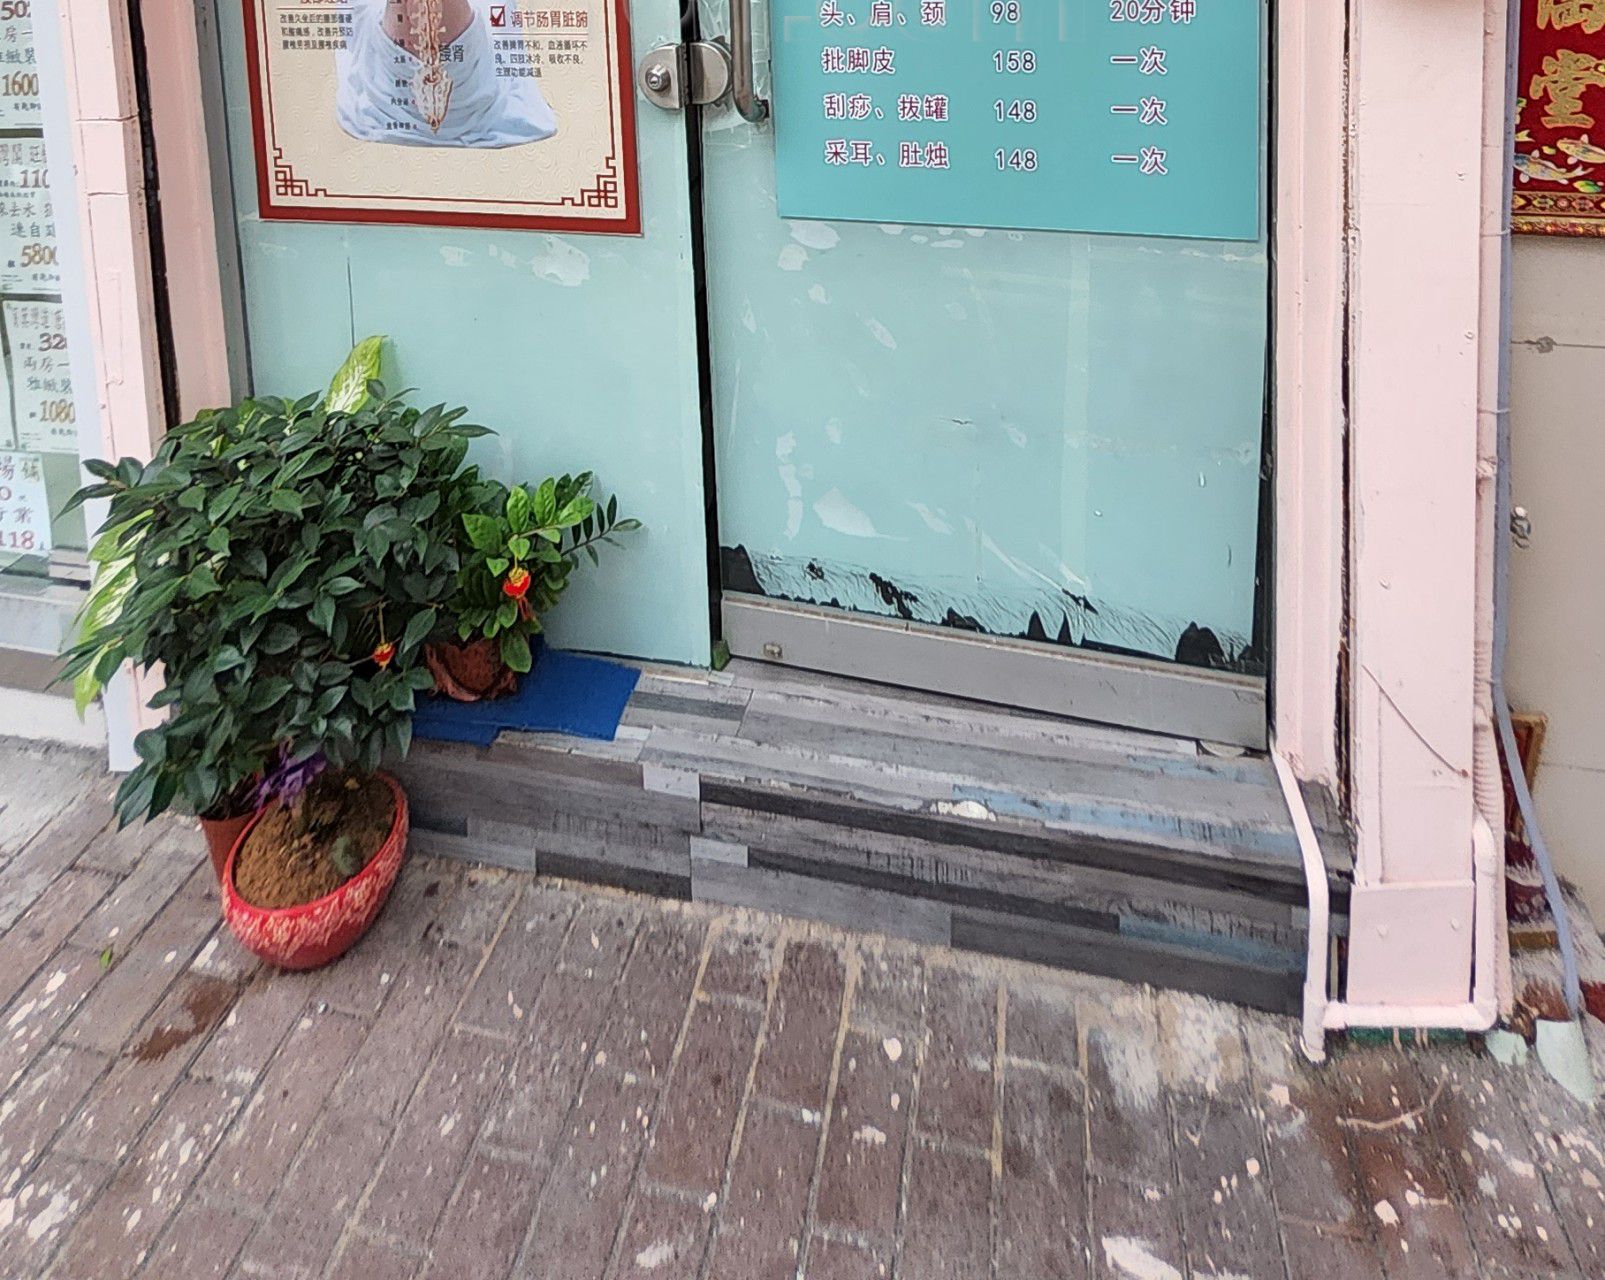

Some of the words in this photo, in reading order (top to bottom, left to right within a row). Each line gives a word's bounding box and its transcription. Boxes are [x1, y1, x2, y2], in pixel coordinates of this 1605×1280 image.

[1, 0, 32, 21] 50
[510, 10, 588, 28] 调节肠胃脏腑
[989, 1, 1021, 23] 98
[820, 46, 896, 75] 批脚皮
[992, 50, 1037, 74] 158
[1110, 45, 1169, 76] 一次
[822, 92, 949, 122] 刮痧、拔罐
[993, 99, 1038, 122] 148
[1110, 96, 1169, 127] 一次
[824, 138, 950, 169] 采耳、肚烛
[993, 148, 1038, 172] 148
[1110, 145, 1170, 176] 一次
[38, 332, 67, 352] 32
